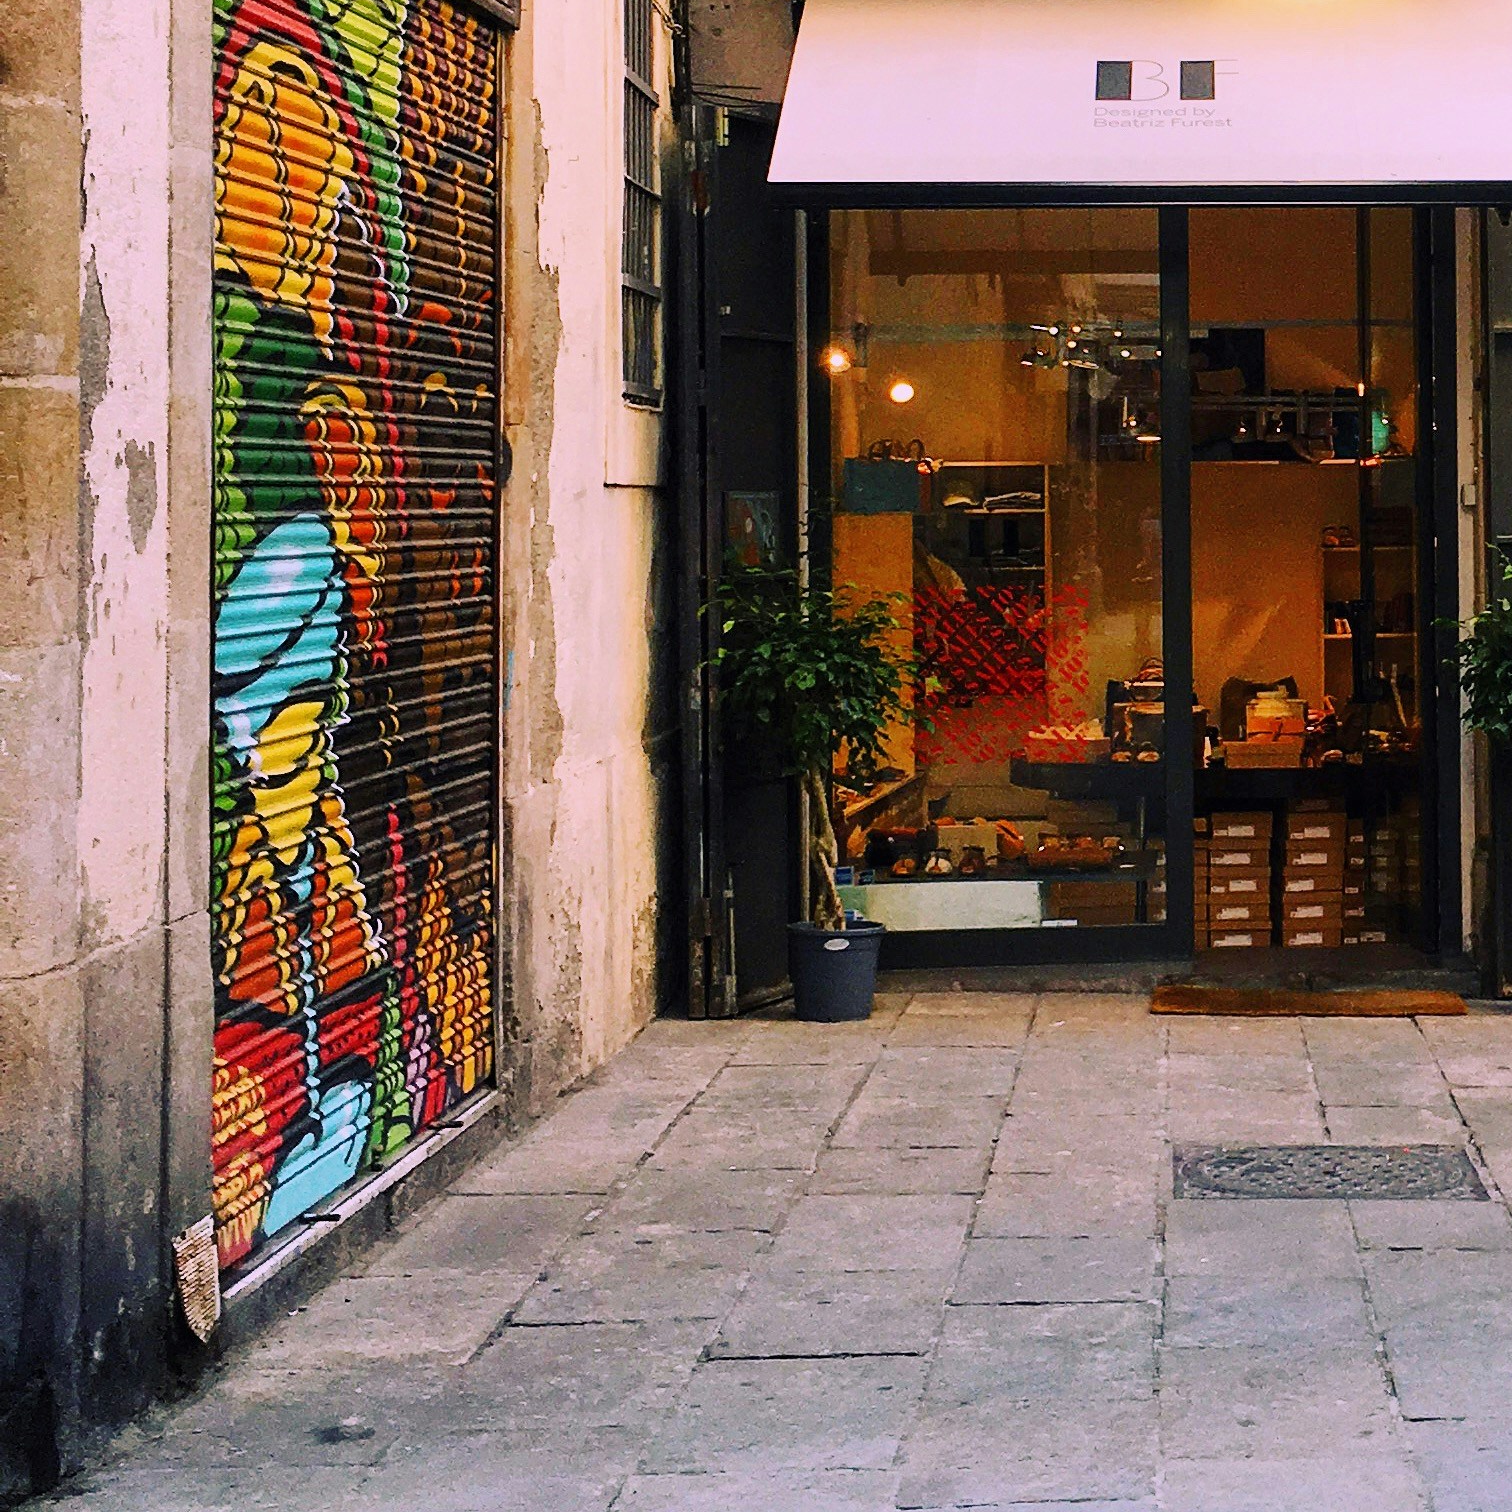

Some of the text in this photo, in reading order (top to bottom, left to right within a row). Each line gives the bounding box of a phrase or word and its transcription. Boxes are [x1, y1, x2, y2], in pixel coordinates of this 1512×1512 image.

[1093, 106, 1217, 119] Designed by
[1093, 117, 1233, 128] Beatriz Furest
